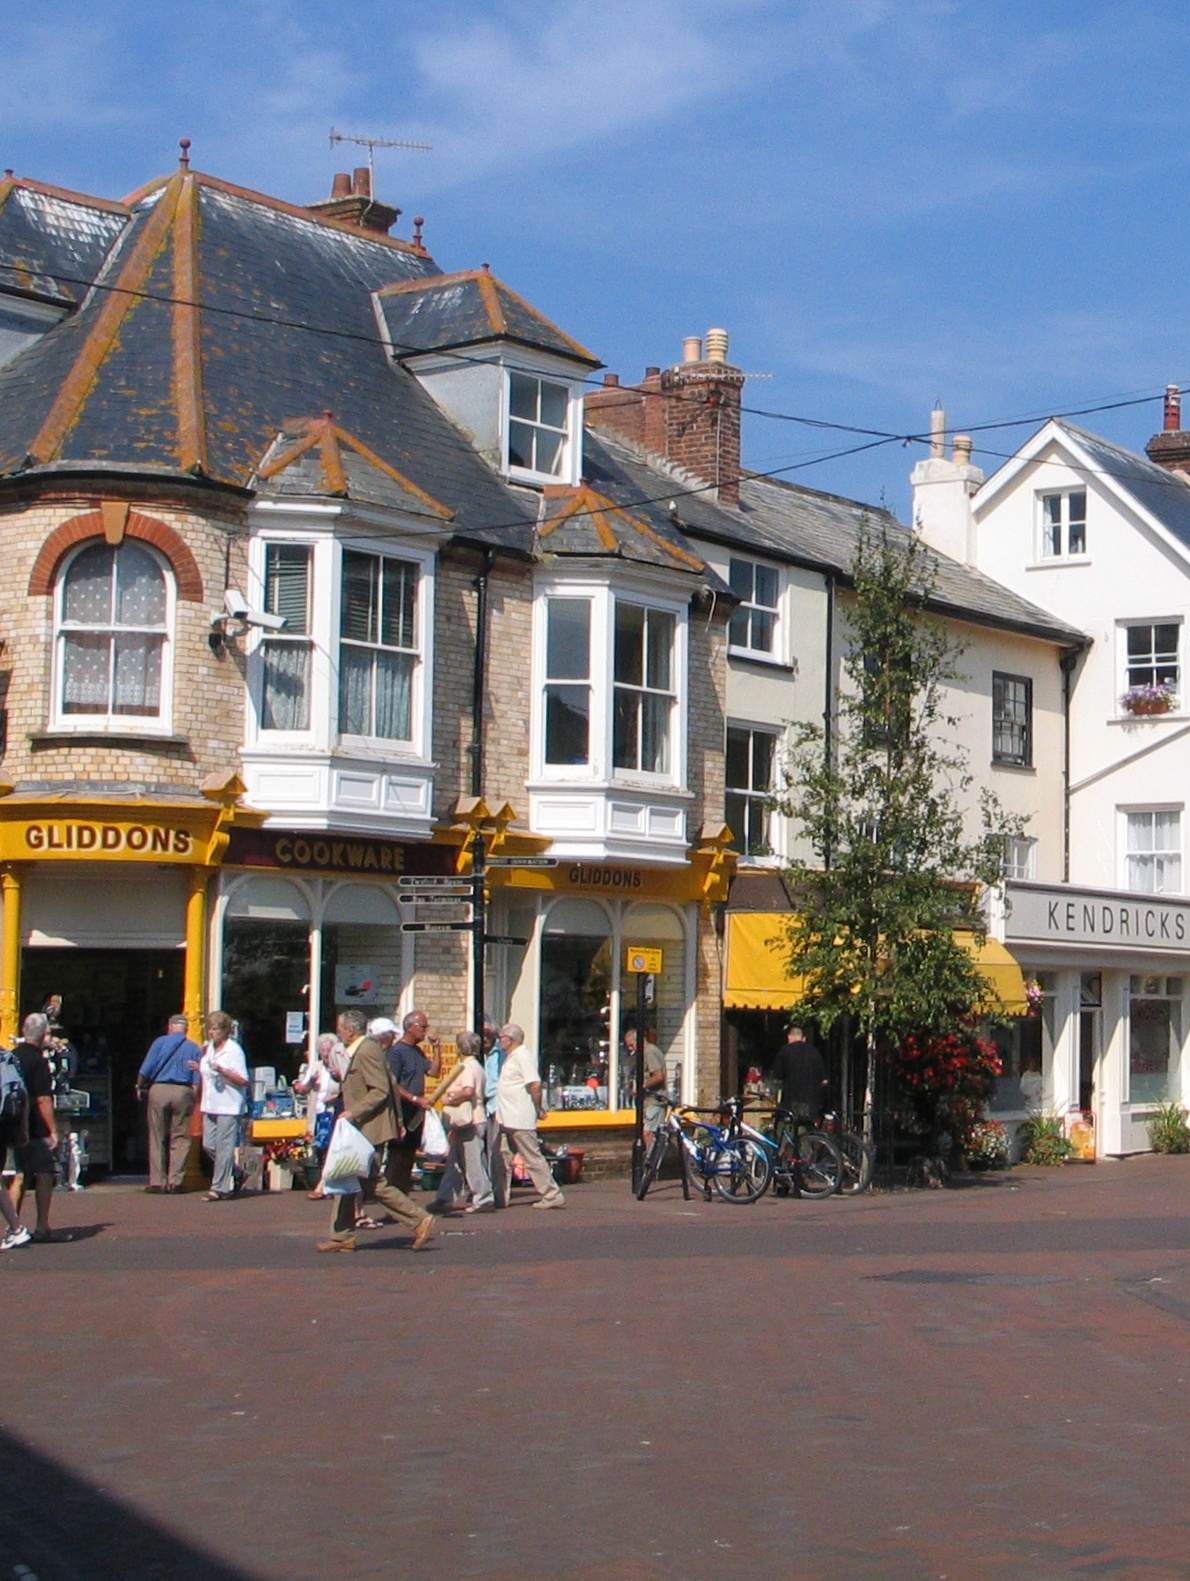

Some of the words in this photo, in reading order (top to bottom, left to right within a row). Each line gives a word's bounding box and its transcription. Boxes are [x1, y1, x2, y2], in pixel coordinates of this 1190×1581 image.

[25, 824, 192, 855] GLIDDONS
[275, 838, 405, 870] COOKWARE
[569, 867, 641, 887] GLIDDONS
[1047, 901, 1185, 940] KENDRICKS
